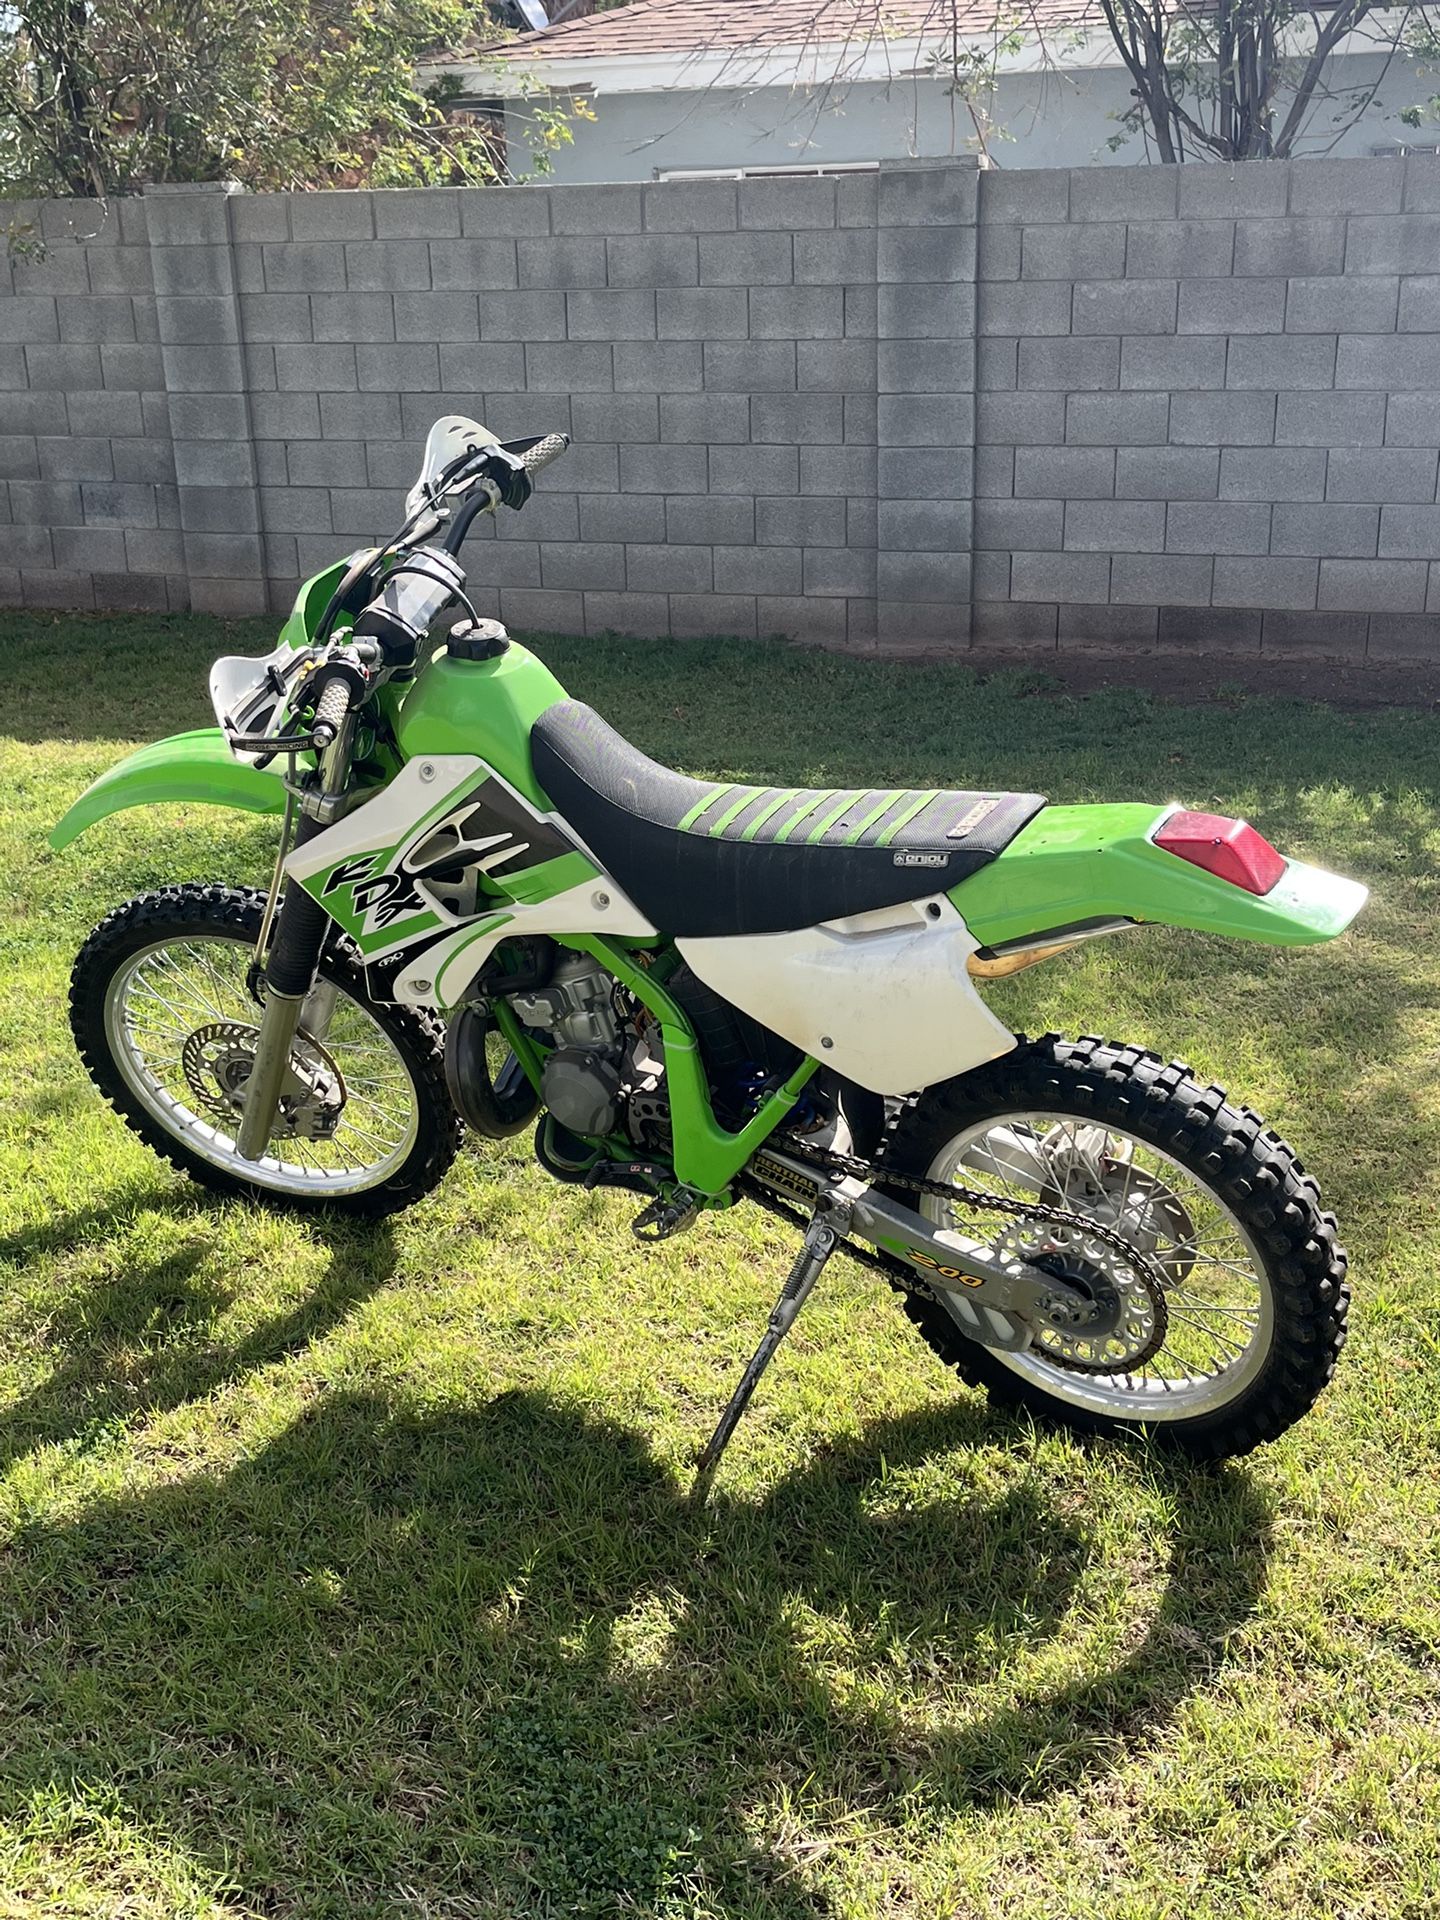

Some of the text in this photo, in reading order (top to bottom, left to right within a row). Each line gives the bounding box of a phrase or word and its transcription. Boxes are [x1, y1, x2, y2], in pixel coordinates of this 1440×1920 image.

[277, 741, 308, 749] RACING
[905, 854, 946, 865] enjoy
[321, 852, 427, 930] KDX
[755, 1165, 816, 1200] CHAIN
[756, 1156, 815, 1189] RENTHAL
[905, 1246, 986, 1289] 200
